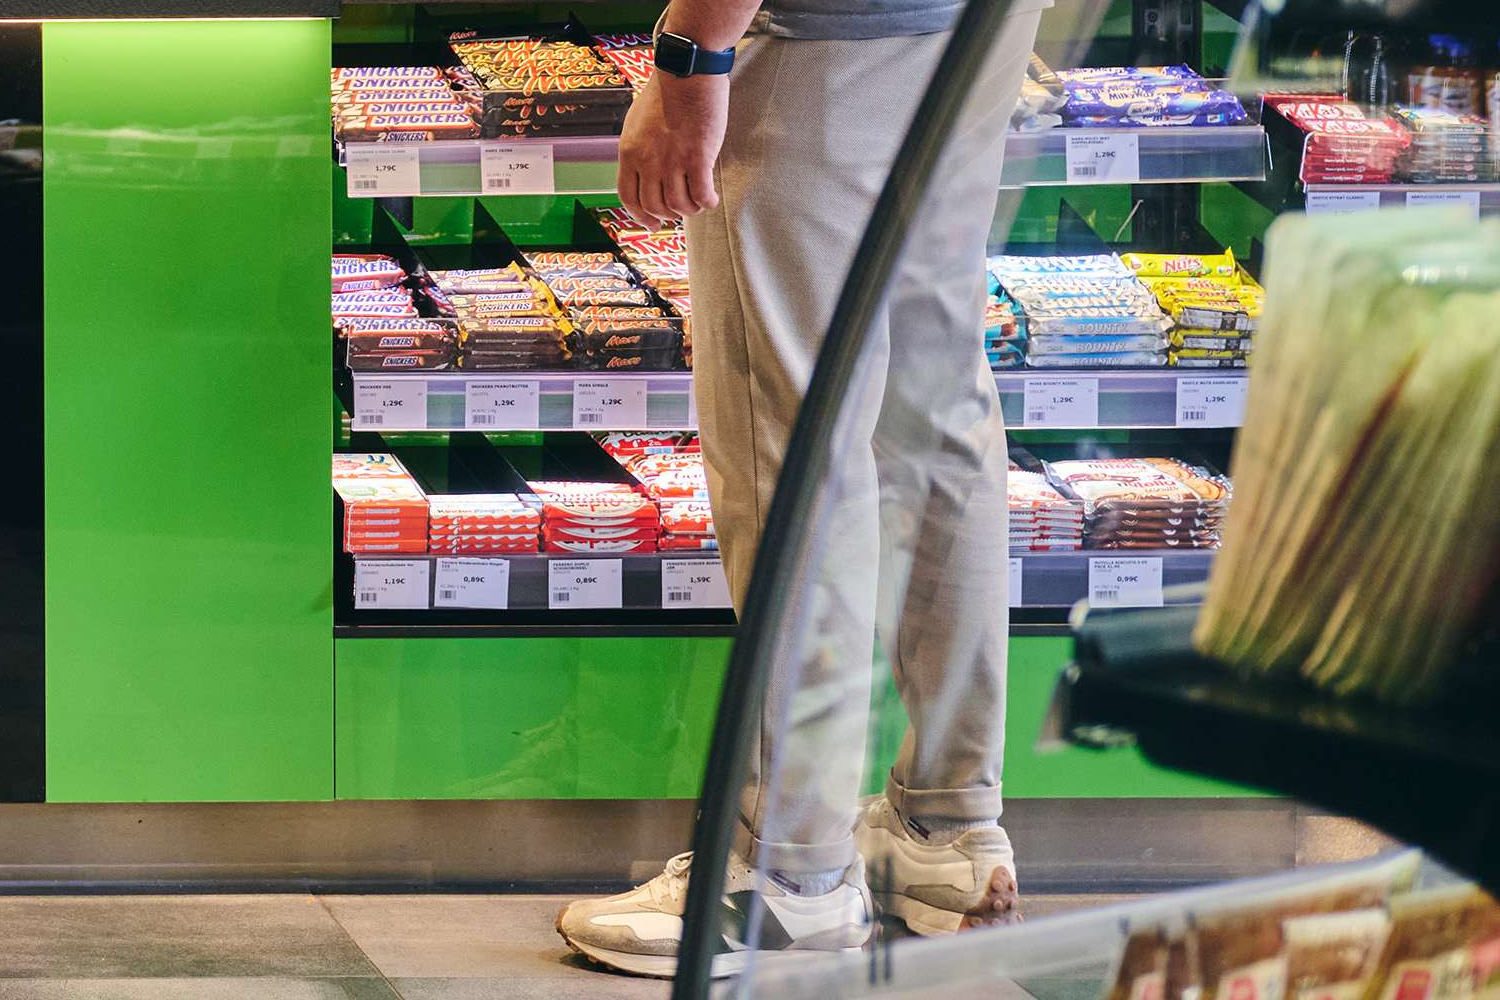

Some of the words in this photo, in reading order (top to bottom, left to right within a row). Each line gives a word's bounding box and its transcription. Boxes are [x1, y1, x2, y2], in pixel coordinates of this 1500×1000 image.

[343, 66, 436, 77] SNICKERS
[353, 78, 446, 87] SNICKERS
[522, 73, 627, 98] Mars
[387, 132, 426, 142] SNICKERS
[375, 164, 397, 173] 1,79€
[508, 163, 530, 171] 1,79€
[332, 262, 399, 276] NICKERS
[342, 281, 373, 290] SNICKERS
[477, 293, 534, 301] SNICKERS
[477, 303, 533, 312] SNICKERS
[489, 318, 542, 326] SNICKERS
[380, 337, 414, 347] SNICKERS
[605, 335, 642, 347] Mars
[384, 356, 418, 367] SNICKERS
[605, 354, 642, 368] Mars
[494, 399, 515, 407] 1,29€
[601, 398, 622, 406] 1,29€
[1052, 396, 1074, 404] 1,29€
[1204, 395, 1226, 403] 1,29€
[384, 577, 406, 585] 1,19€
[463, 575, 485, 584] 0,89€
[575, 575, 598, 584] 0,89€
[689, 575, 711, 584] 1,59€
[1116, 575, 1139, 583] 0,99€
